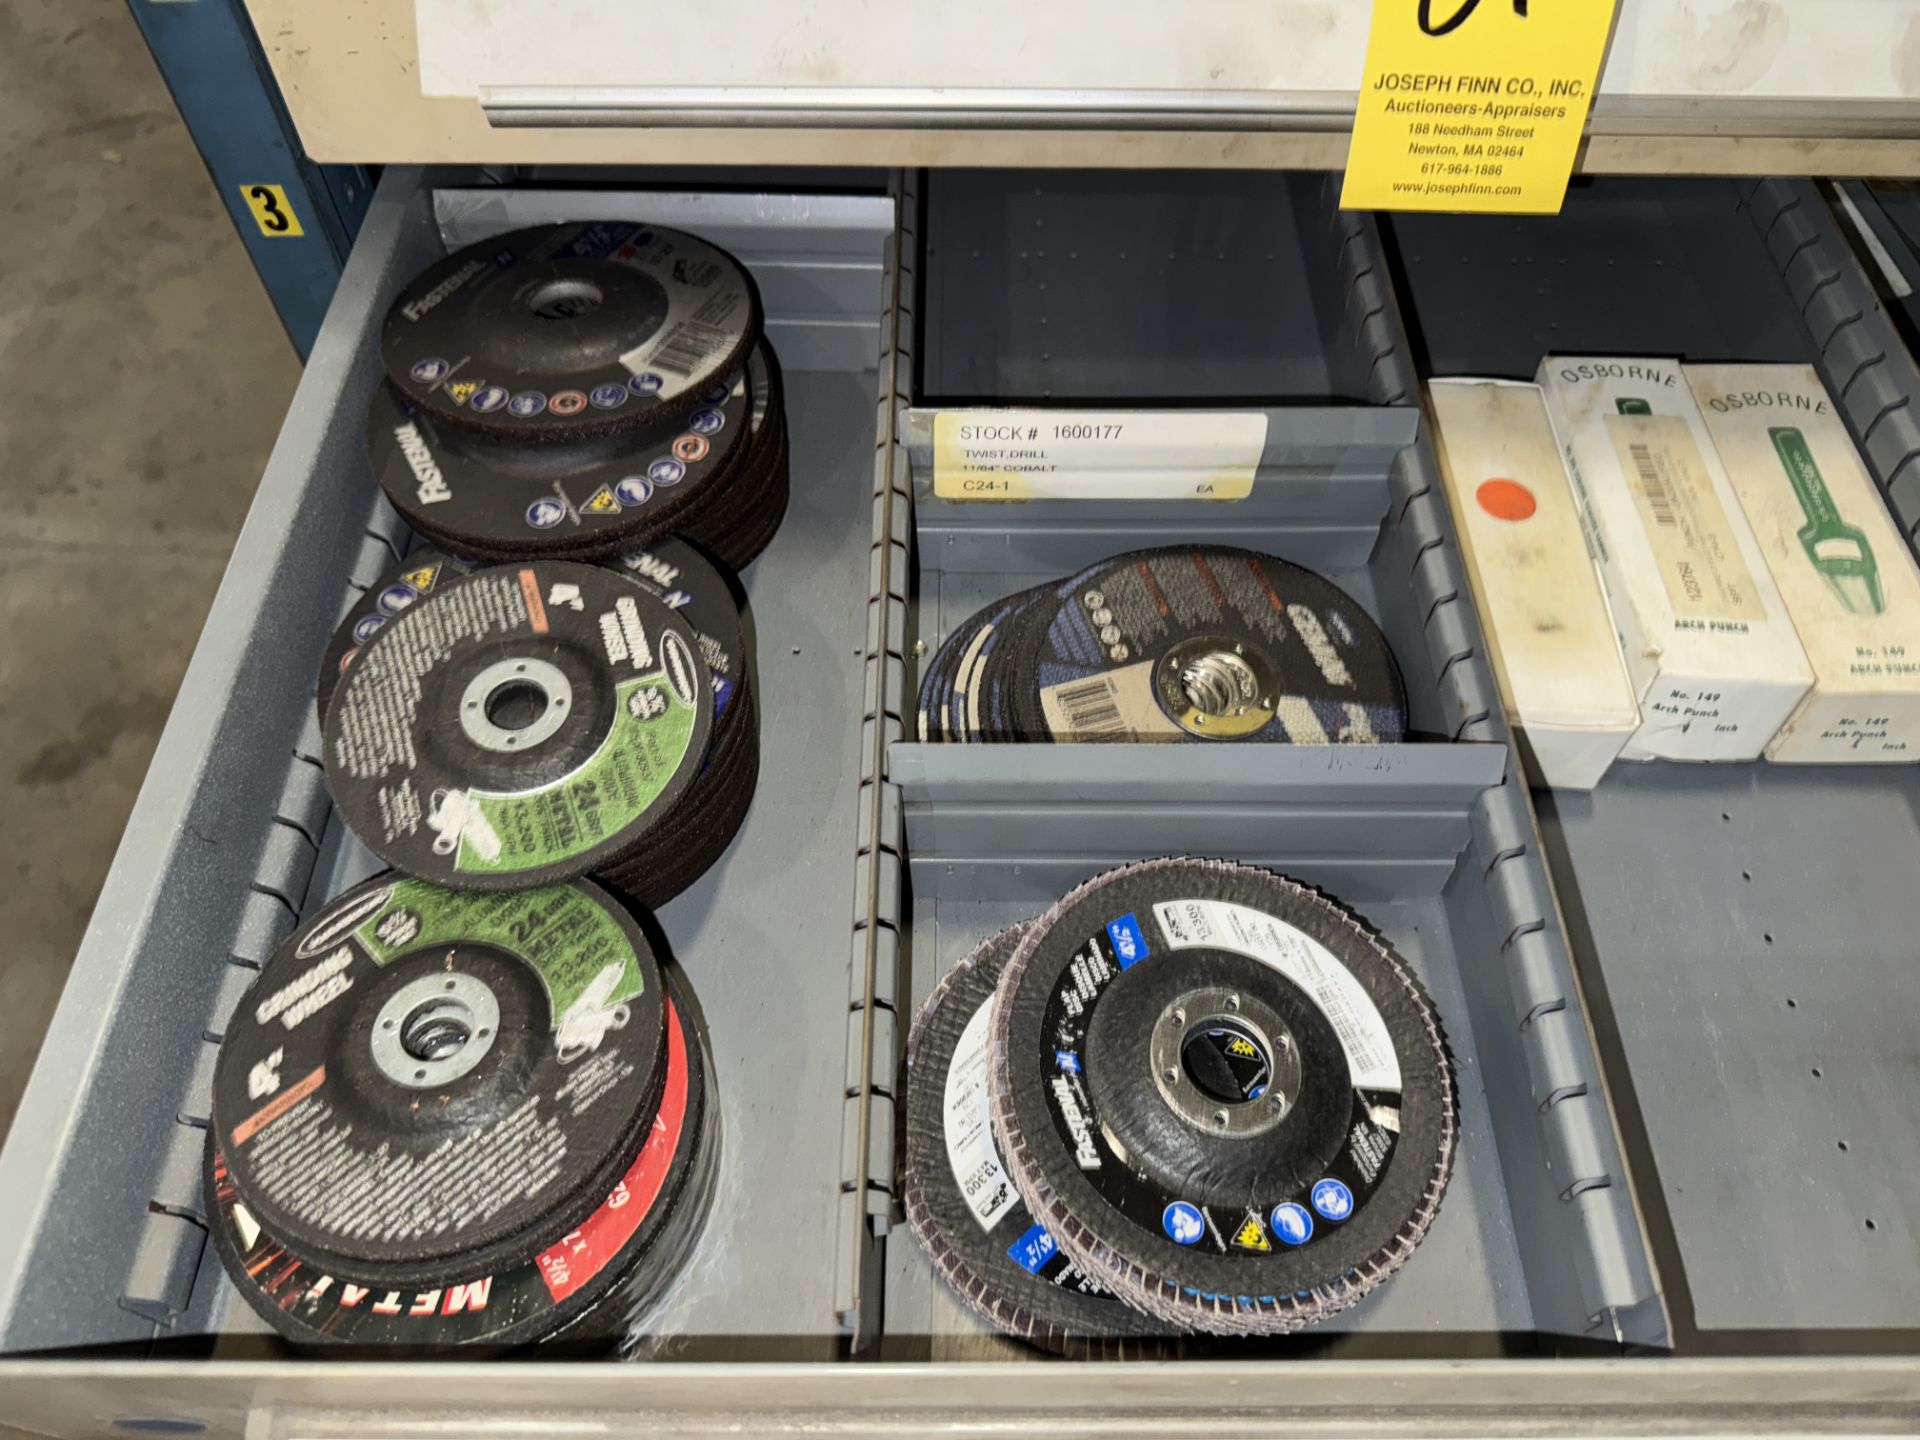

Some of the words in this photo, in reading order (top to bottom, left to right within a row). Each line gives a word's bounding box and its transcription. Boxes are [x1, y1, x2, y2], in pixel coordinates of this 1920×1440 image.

[1374, 73, 1451, 91] JOSEPH
[1457, 76, 1500, 94] FINN
[1506, 78, 1543, 98] CO.,
[1550, 79, 1586, 97] INC.
[1384, 98, 1567, 119] Auctioneers-Appraisers
[1408, 123, 1430, 134] 188
[1434, 123, 1493, 137] Needham
[1497, 126, 1535, 138] Street
[1408, 142, 1459, 157] Newton,
[1463, 144, 1483, 156] MA
[1487, 145, 1524, 157] 02464
[1421, 163, 1503, 175] 617-964-1886
[1392, 181, 1522, 196] www.josephfinn.com
[250, 185, 291, 233] 3
[1560, 363, 1678, 388] OSBORNE
[1709, 391, 1828, 415] OSBORNE
[961, 425, 1022, 440] STOCK
[1027, 425, 1039, 440] #
[1053, 425, 1123, 440] 1600177
[1003, 464, 1058, 473] COBALT
[963, 480, 1010, 491] C24-1
[1196, 484, 1214, 494] EA
[1709, 621, 1749, 633] PUNCH
[1886, 663, 1920, 675] PUNC
[1670, 689, 1690, 701] No.
[1697, 692, 1721, 702] 149
[1652, 702, 1679, 714] Arch
[1683, 706, 1719, 718] Punch
[1714, 724, 1739, 733] Inch
[1838, 717, 1858, 726] No.
[1866, 717, 1889, 726] 149
[1821, 730, 1846, 739] Arch
[1850, 730, 1888, 739] Punch
[1882, 742, 1907, 751] Inch
[570, 776, 602, 812] 24
[507, 906, 549, 945] 24
[1089, 937, 1110, 982] LAMINADO
[1088, 956, 1103, 985] DISCO
[1070, 963, 1090, 1002] DISQUE
[281, 970, 354, 1031] WHEEL
[1060, 989, 1076, 1018] FLAP
[1069, 988, 1084, 1016] DISC
[1051, 1073, 1102, 1170] FASTENAL
[1353, 1123, 1381, 1169] FASTENAL
